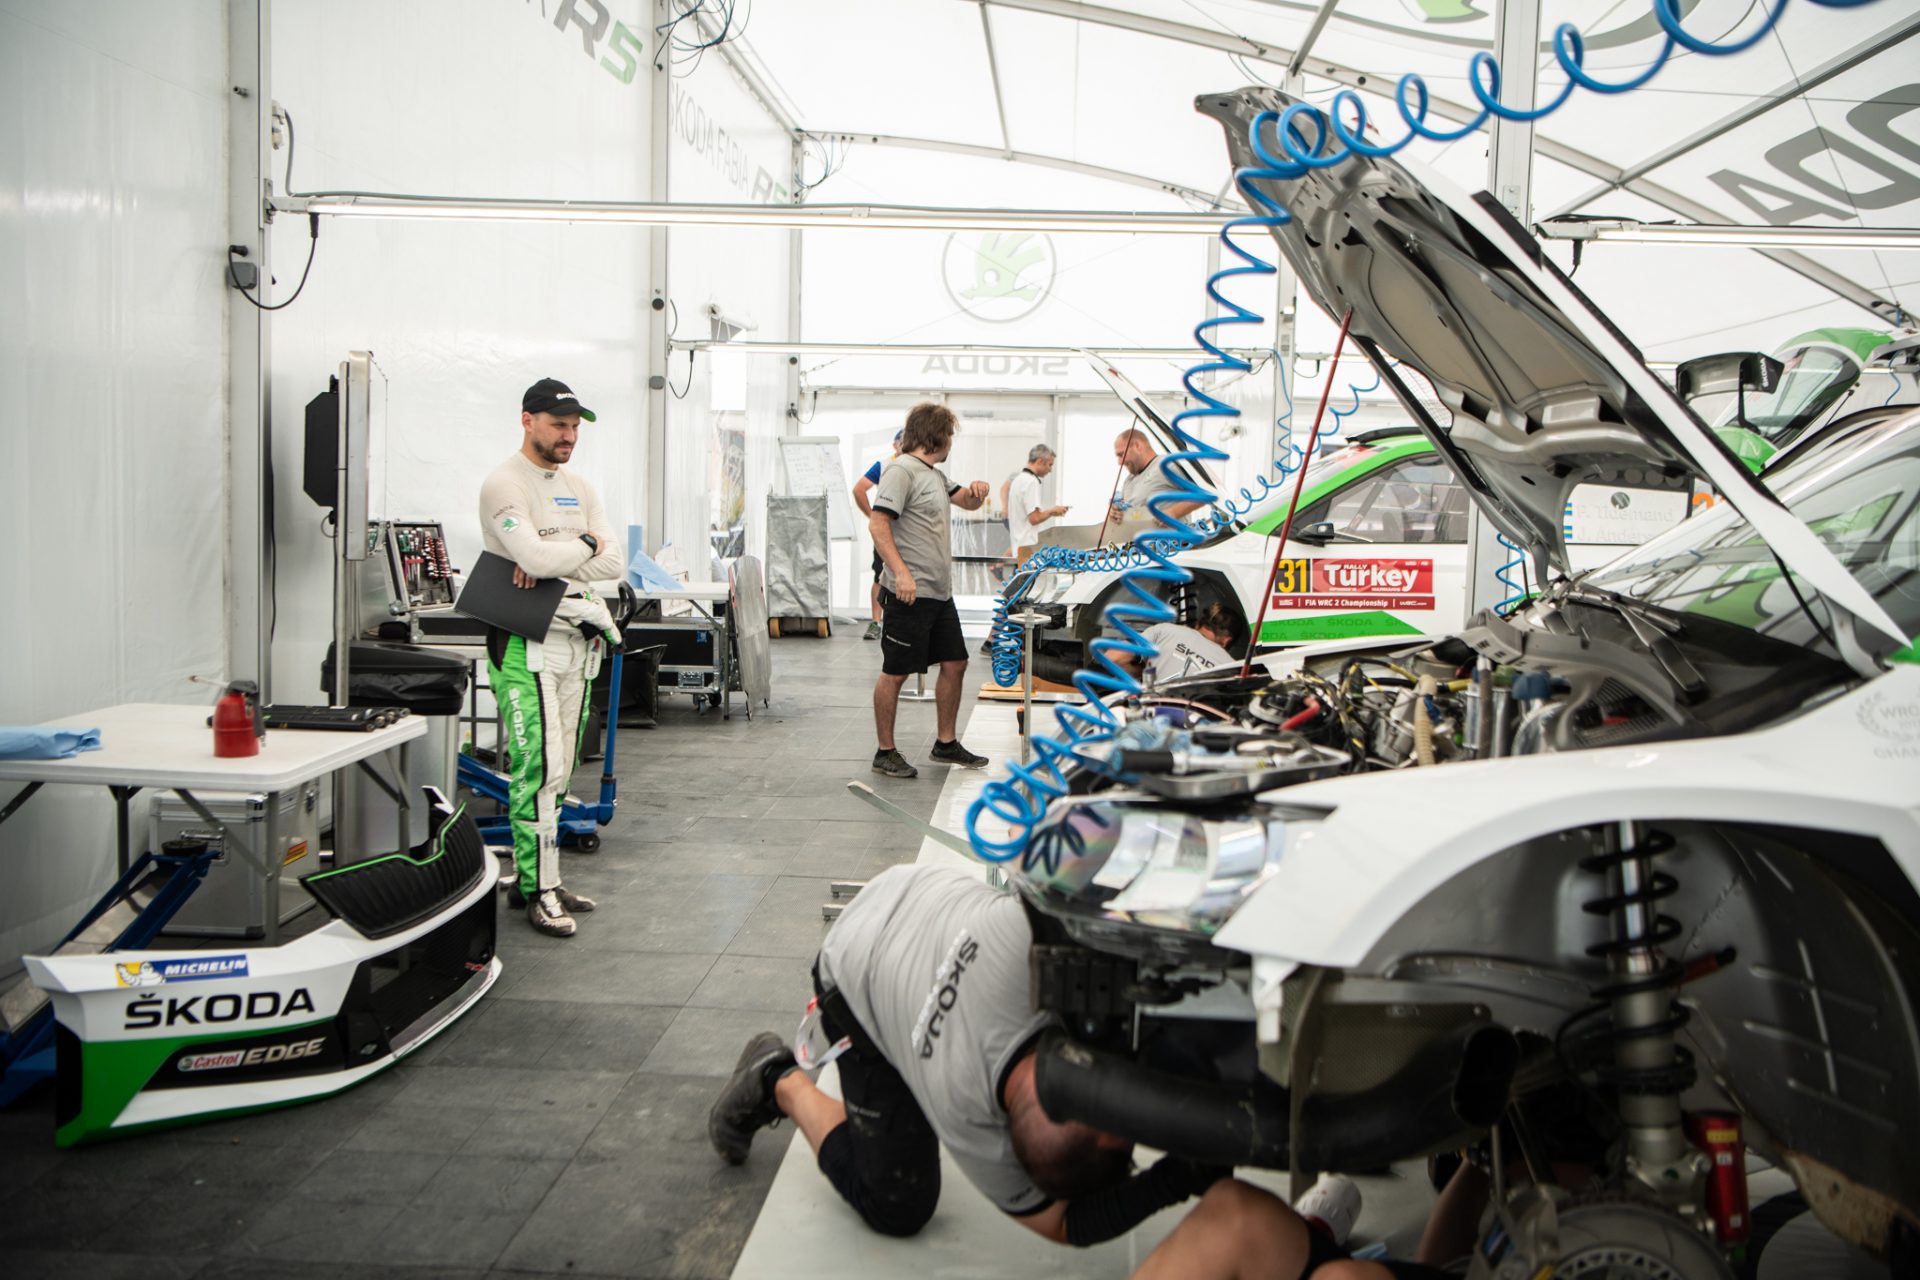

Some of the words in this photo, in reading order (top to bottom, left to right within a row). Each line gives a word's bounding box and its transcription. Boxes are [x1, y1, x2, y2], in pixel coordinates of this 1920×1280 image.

[671, 80, 715, 167] KODA
[1278, 559, 1307, 593] 31
[1323, 564, 1419, 592] Turkey
[1305, 599, 1316, 607] FIA
[1318, 599, 1333, 607] WRC
[1334, 599, 1339, 607] 2
[1340, 598, 1388, 608] Championship
[164, 959, 247, 976] MICHELIN
[124, 987, 315, 1030] ŠKODA
[193, 1053, 240, 1070] Castrol
[242, 1036, 327, 1066] EDGE
